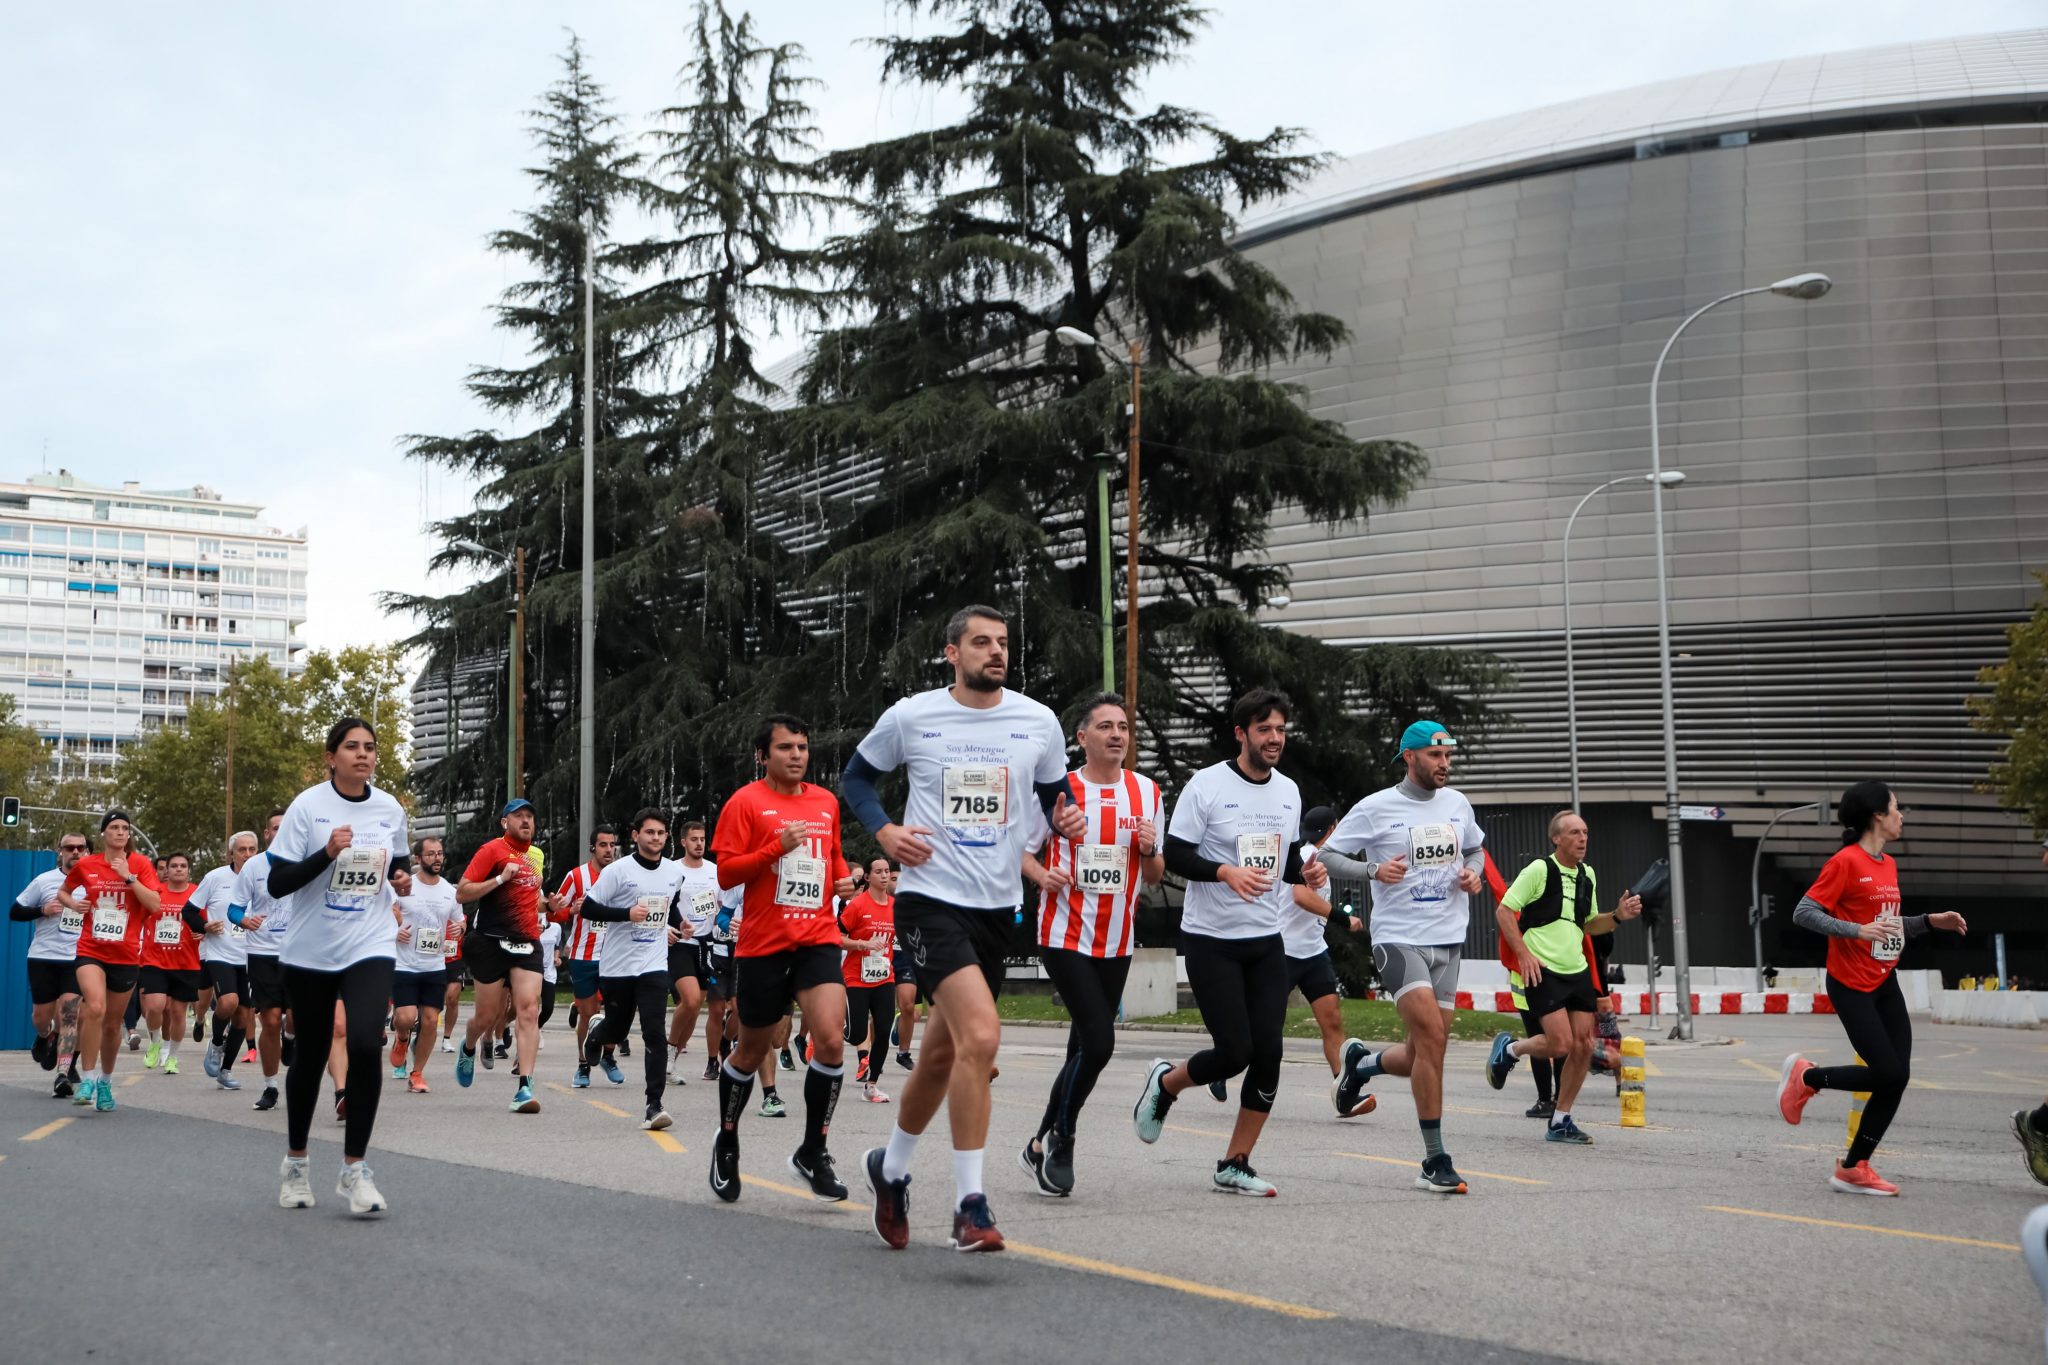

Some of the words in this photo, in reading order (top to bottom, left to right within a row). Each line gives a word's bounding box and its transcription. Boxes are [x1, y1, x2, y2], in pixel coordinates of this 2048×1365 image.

[946, 745, 961, 753] Soy
[964, 744, 1006, 755] Merengue
[950, 796, 999, 814] 7185
[1415, 843, 1455, 860] 8364
[1244, 856, 1276, 870] 8367
[338, 871, 378, 886] 1336
[1083, 869, 1122, 884] 1098
[786, 881, 820, 898] 7318
[695, 902, 715, 913] 5893
[646, 912, 665, 922] 607
[94, 923, 123, 934] 6280
[158, 931, 179, 939] 3762
[421, 940, 439, 949] 346
[864, 969, 888, 977] 7464
